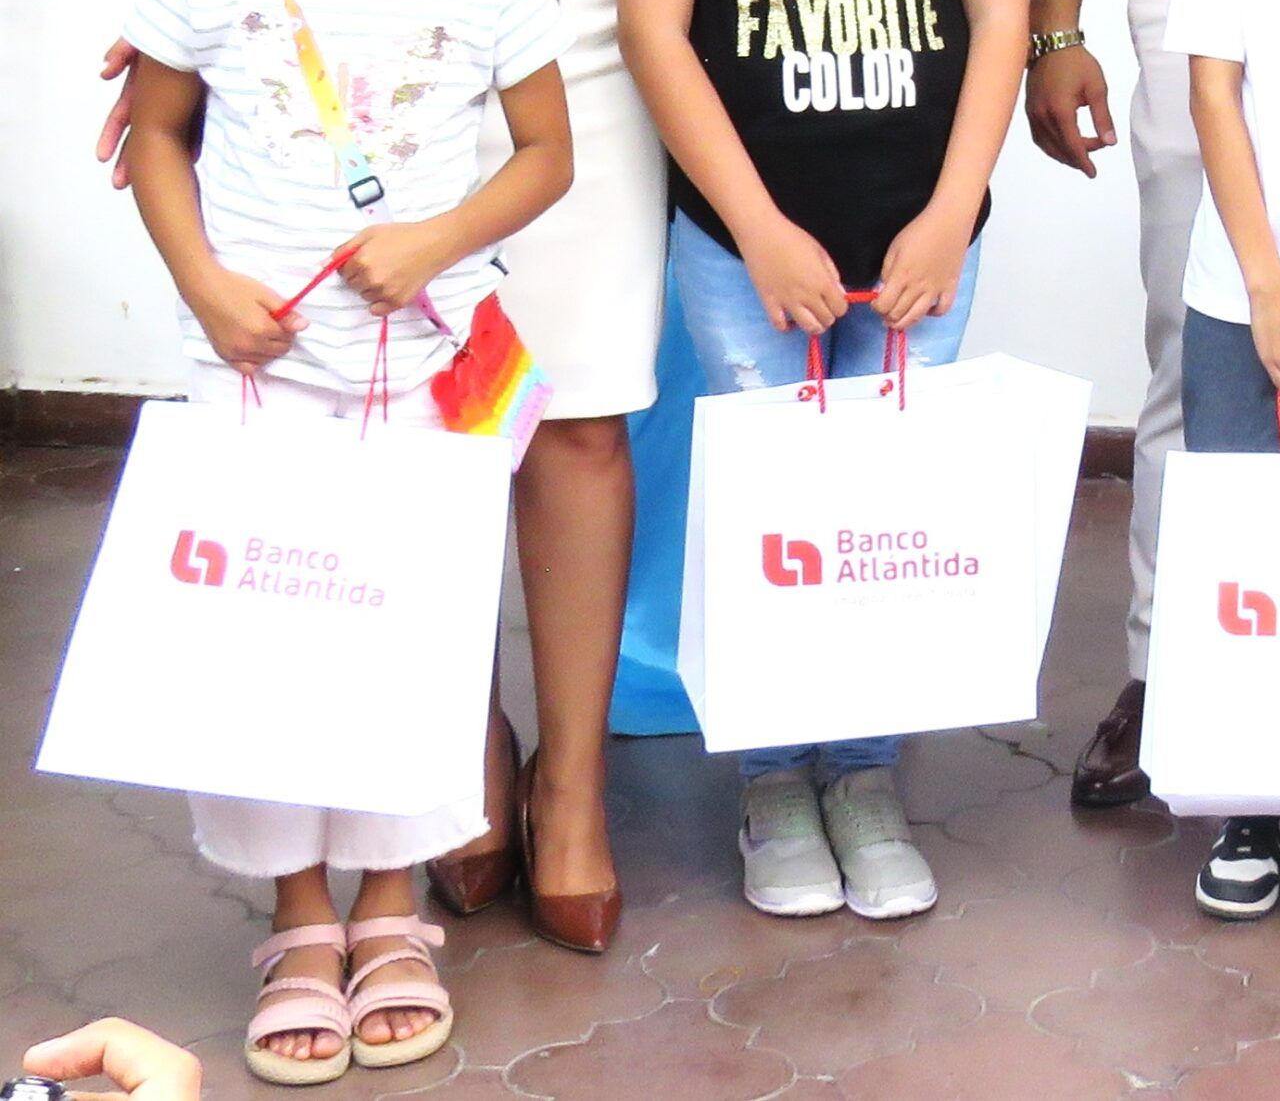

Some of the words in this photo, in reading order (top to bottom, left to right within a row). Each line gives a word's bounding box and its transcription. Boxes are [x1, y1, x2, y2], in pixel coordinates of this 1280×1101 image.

[782, 48, 917, 113] COLOR
[244, 537, 339, 572] Banco
[837, 530, 928, 555] Banco
